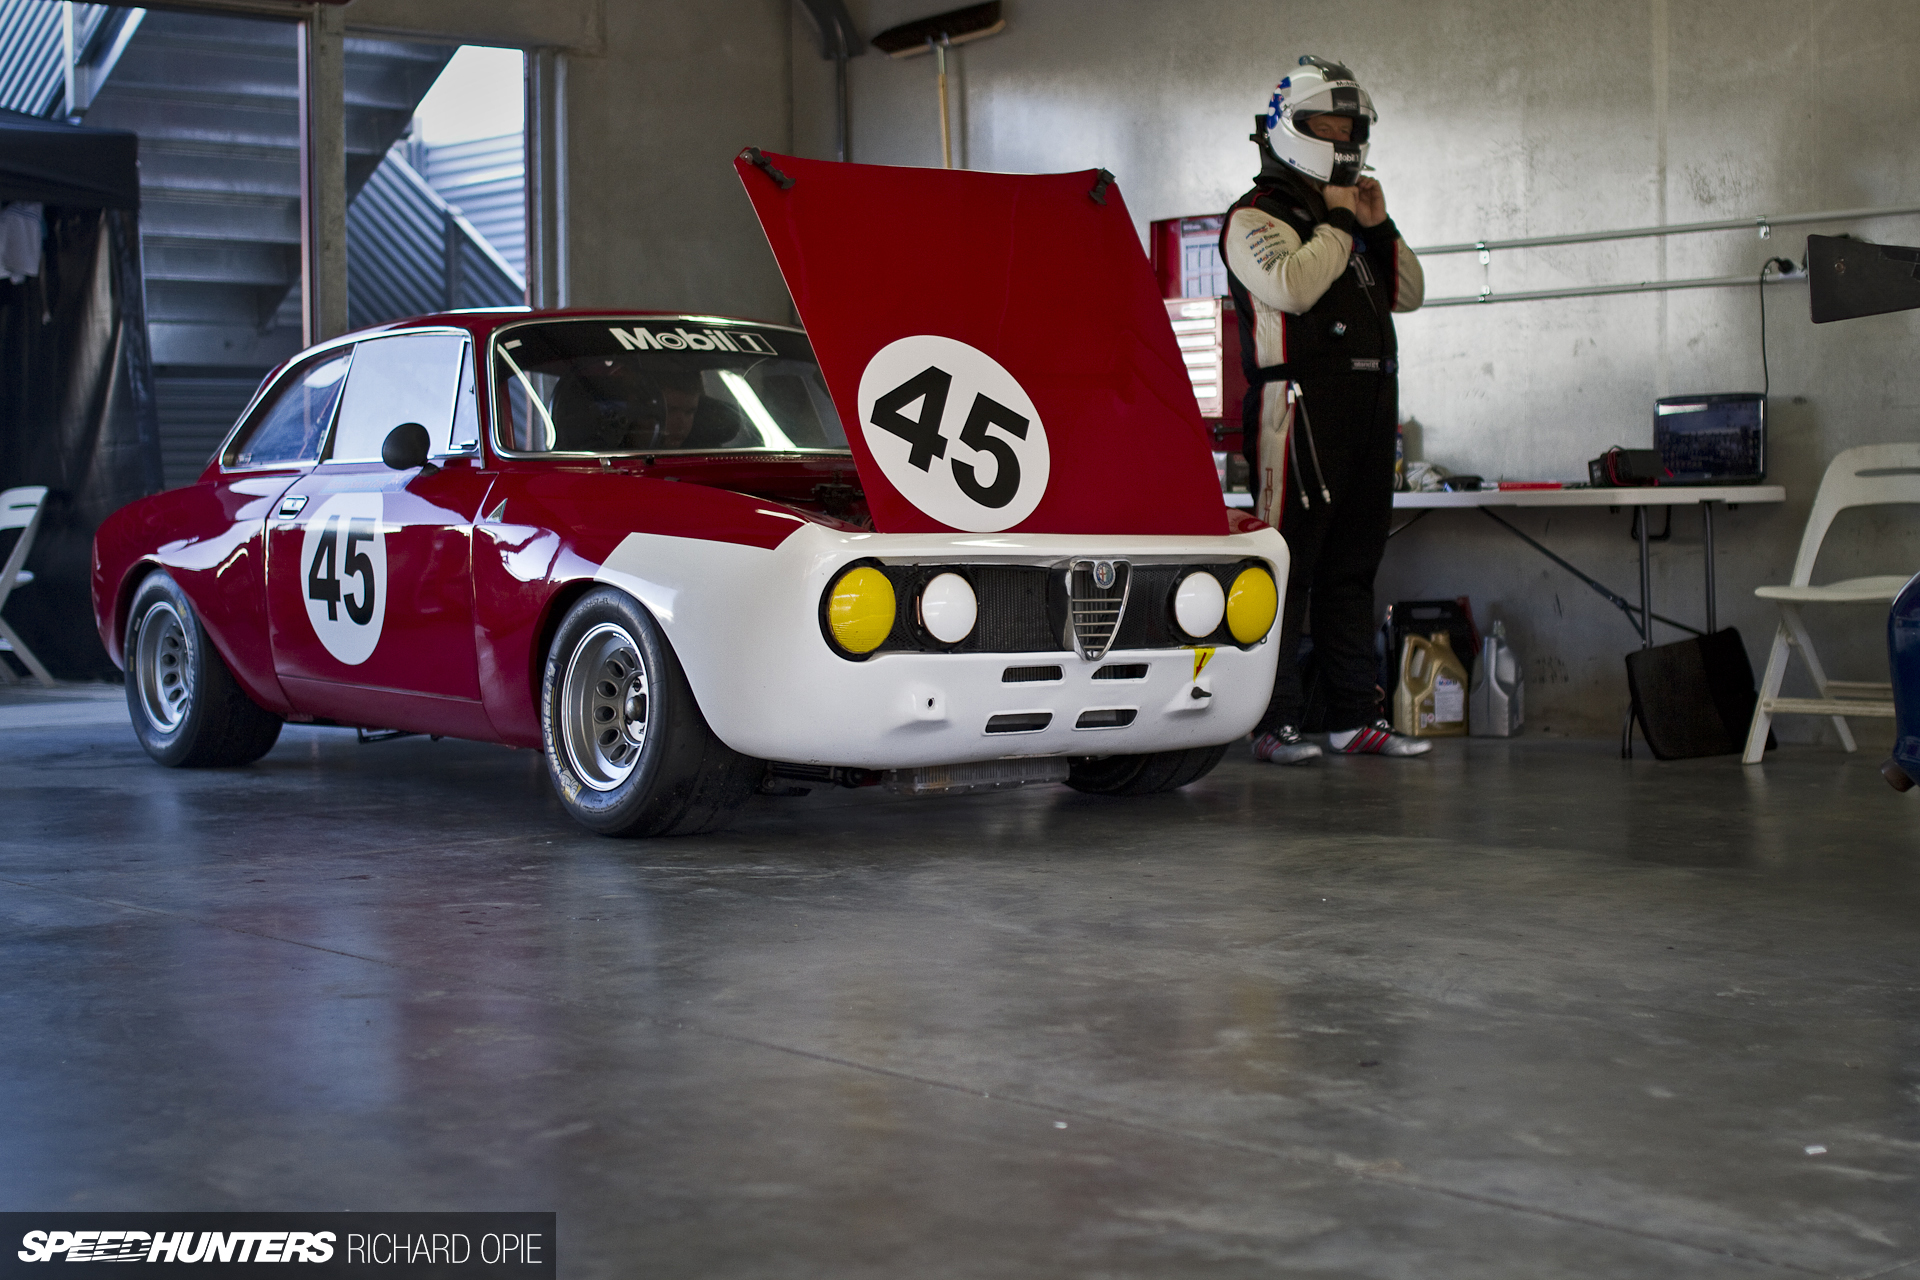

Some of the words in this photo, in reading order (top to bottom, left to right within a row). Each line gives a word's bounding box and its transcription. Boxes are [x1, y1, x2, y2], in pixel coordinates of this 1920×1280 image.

[1334, 152, 1355, 165] Mobil
[609, 327, 739, 352] Mobil
[870, 365, 1030, 509] 45
[308, 515, 377, 625] 45
